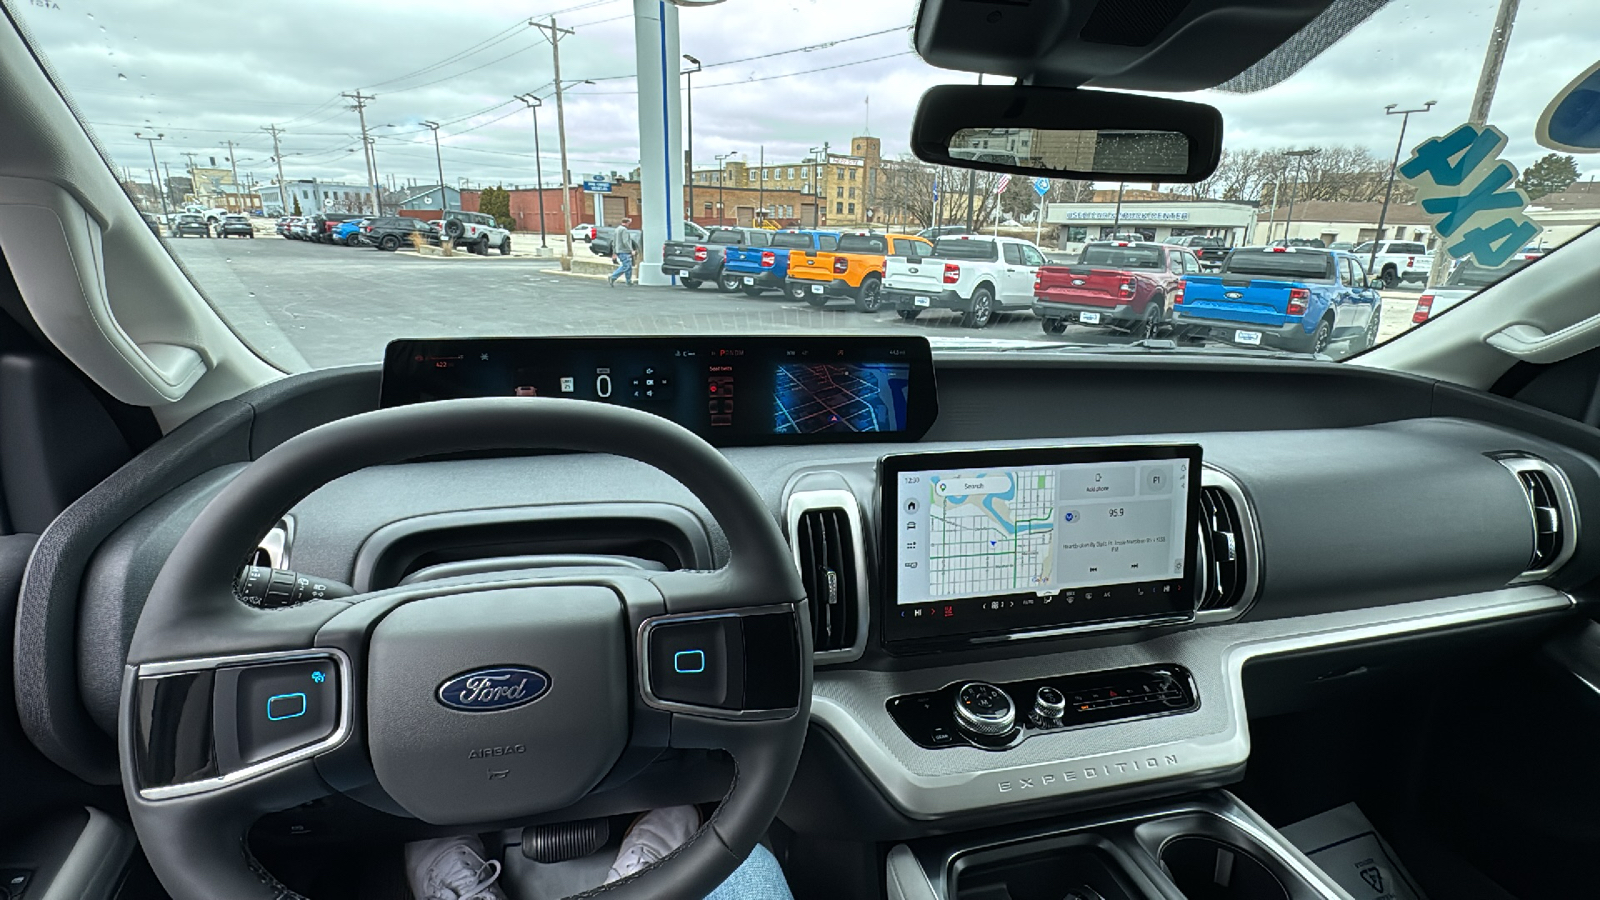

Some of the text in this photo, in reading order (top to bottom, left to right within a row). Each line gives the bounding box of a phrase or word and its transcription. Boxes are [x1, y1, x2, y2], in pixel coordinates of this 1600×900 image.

[1108, 508, 1124, 517] 95.9
[459, 674, 528, 704] Ford
[468, 744, 527, 760] AIRBAG
[998, 754, 1178, 792] EXPEDITION
